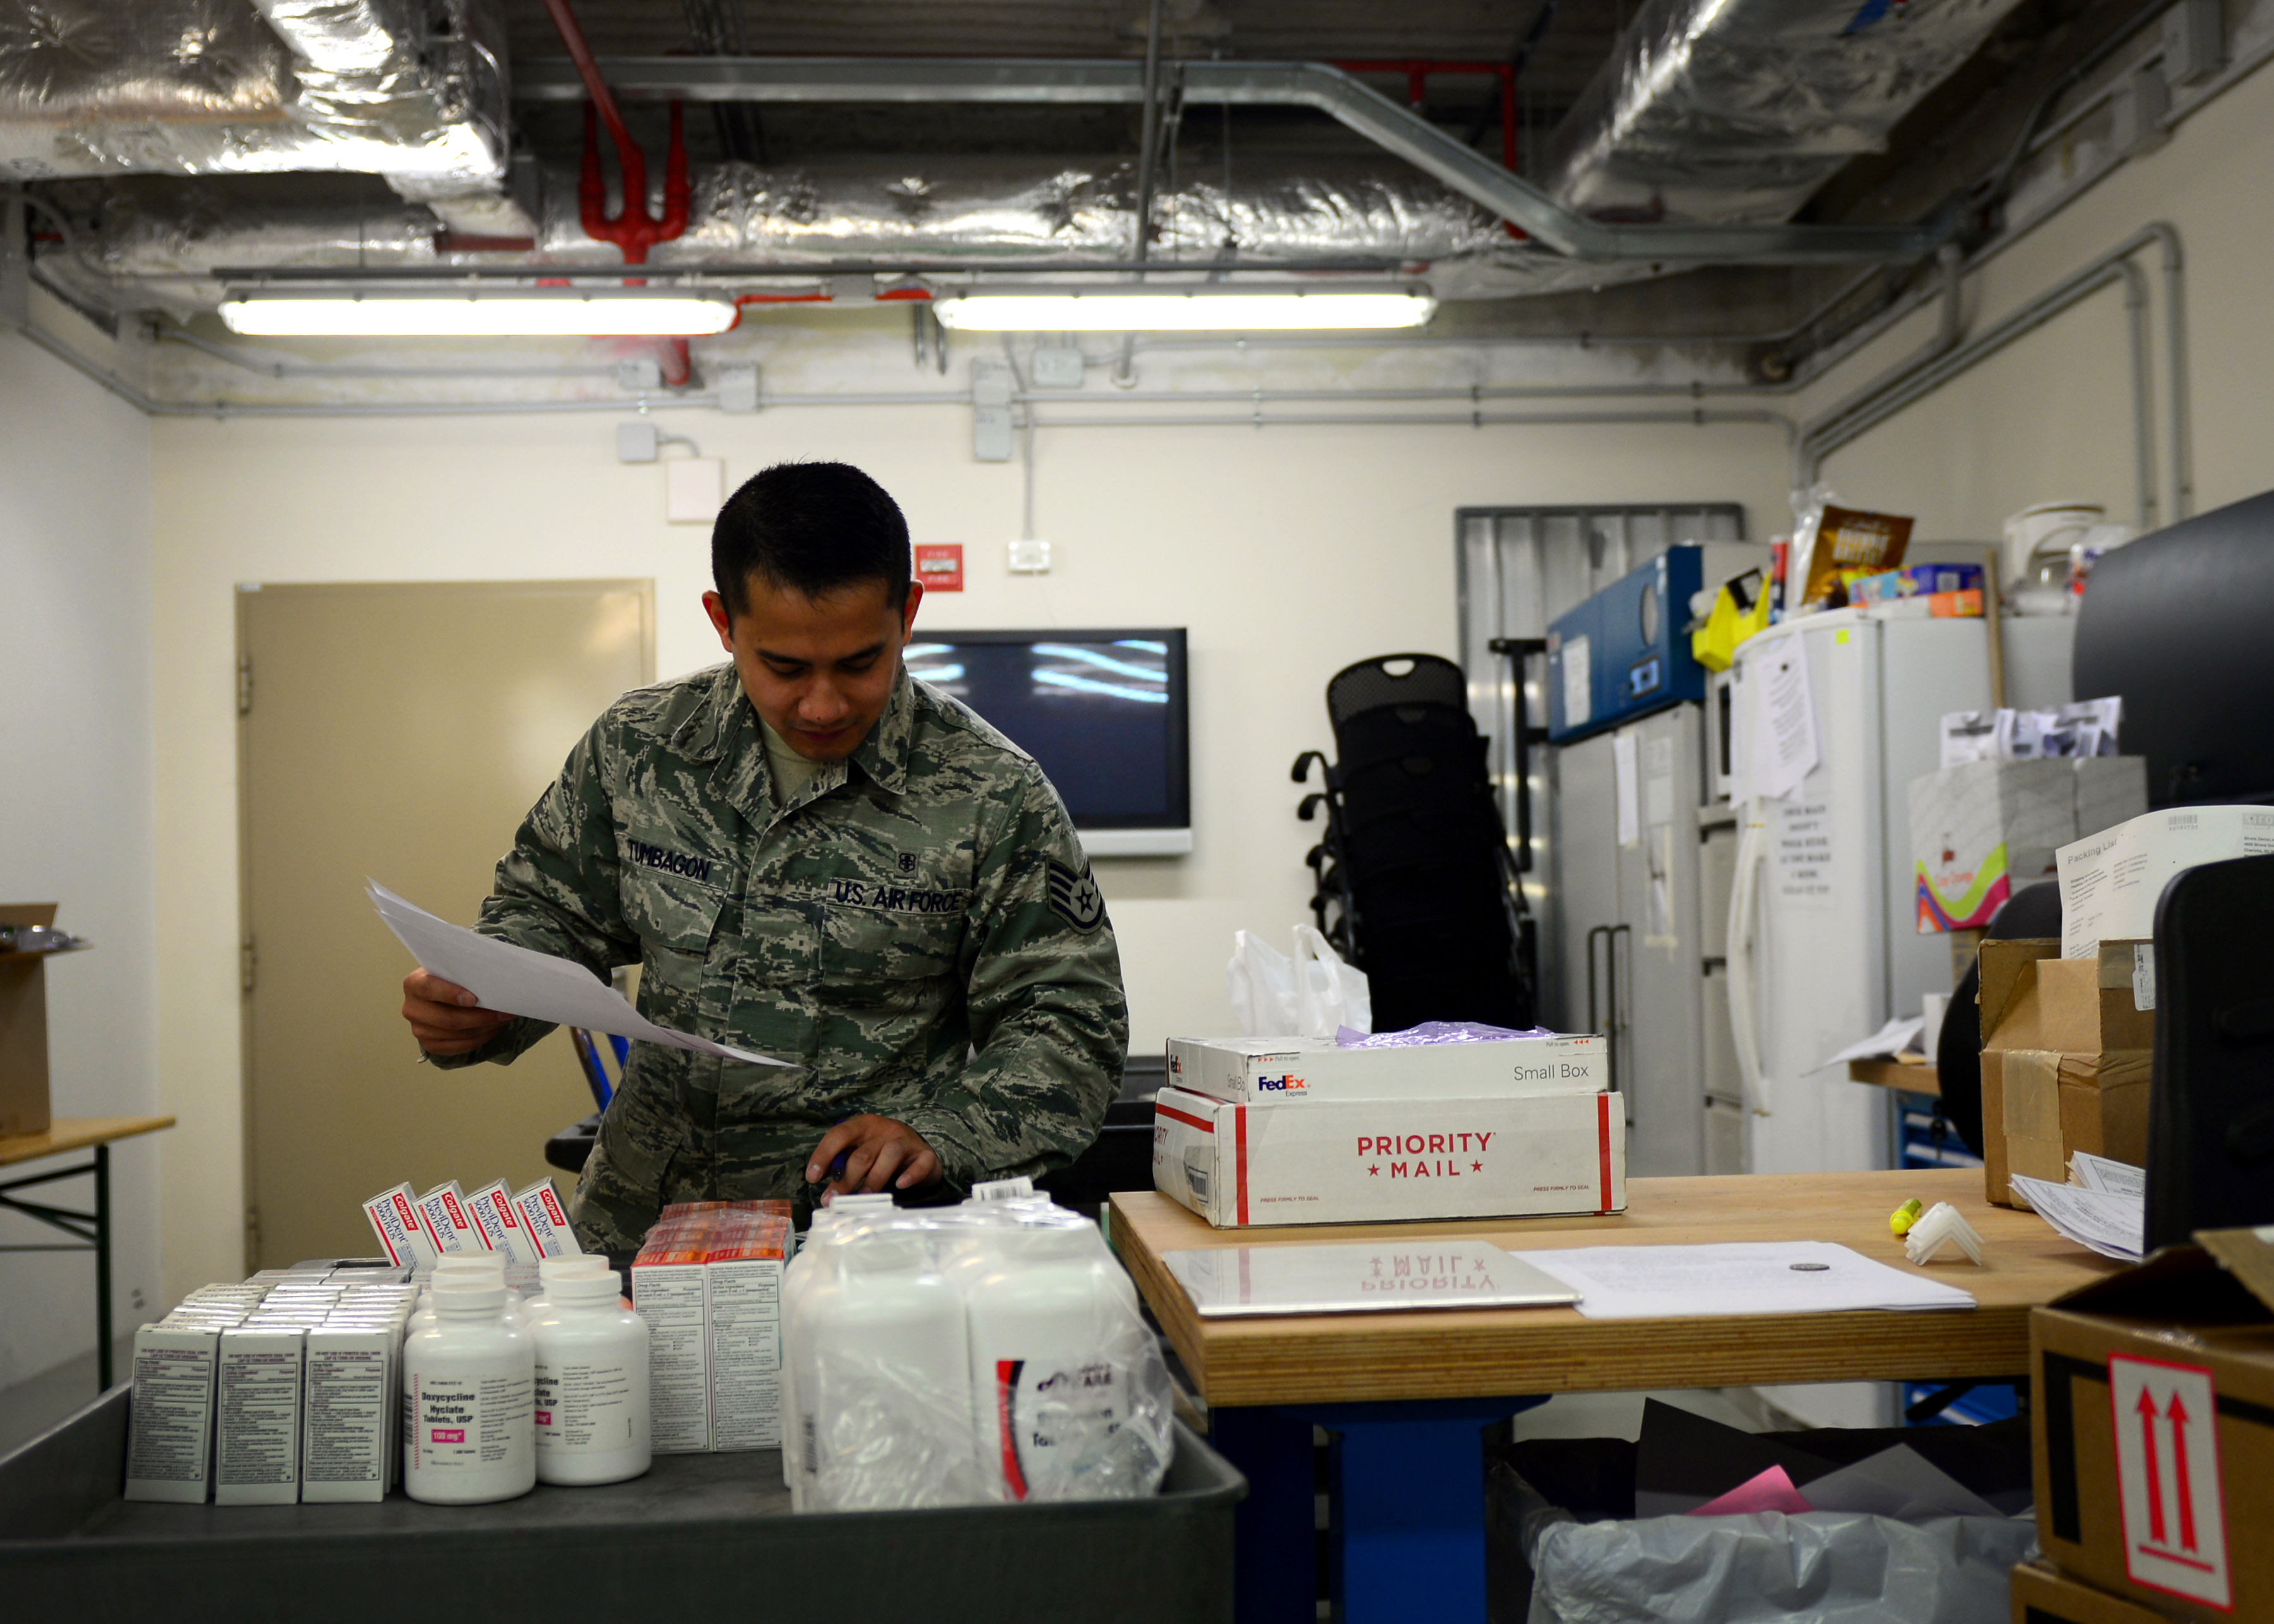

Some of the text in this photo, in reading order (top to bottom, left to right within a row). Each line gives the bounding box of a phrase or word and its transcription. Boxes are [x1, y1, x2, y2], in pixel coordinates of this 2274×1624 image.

[628, 838, 711, 882] TUMBAGON
[2068, 838, 2117, 865] Packing List
[835, 881, 963, 913] U.S. AIR FORCE
[1258, 1074, 1305, 1091] FedEx
[1514, 1064, 1589, 1081] Small Box
[1357, 1132, 1493, 1156] PRIORITY
[1391, 1159, 1461, 1179] MAIL
[375, 1202, 396, 1240] 5000 PLUS
[381, 1198, 406, 1242] PreviDent
[395, 1195, 415, 1229] Colgate
[424, 1201, 446, 1239] 5000 PLUS
[431, 1197, 455, 1241] PreviDent
[444, 1194, 464, 1227] Colgate
[474, 1199, 495, 1237] 5000 PLUS
[480, 1195, 504, 1240] PreviDent
[494, 1193, 513, 1226] Colgate
[522, 1198, 544, 1236] 5000 PLUS
[529, 1194, 554, 1238] PreviDent
[543, 1191, 562, 1224] Colgate
[421, 1392, 475, 1403] Doxycycline
[429, 1405, 465, 1416] Hyclate
[544, 1399, 558, 1407] USP
[433, 1431, 446, 1440] 100
[456, 1415, 473, 1424] USP
